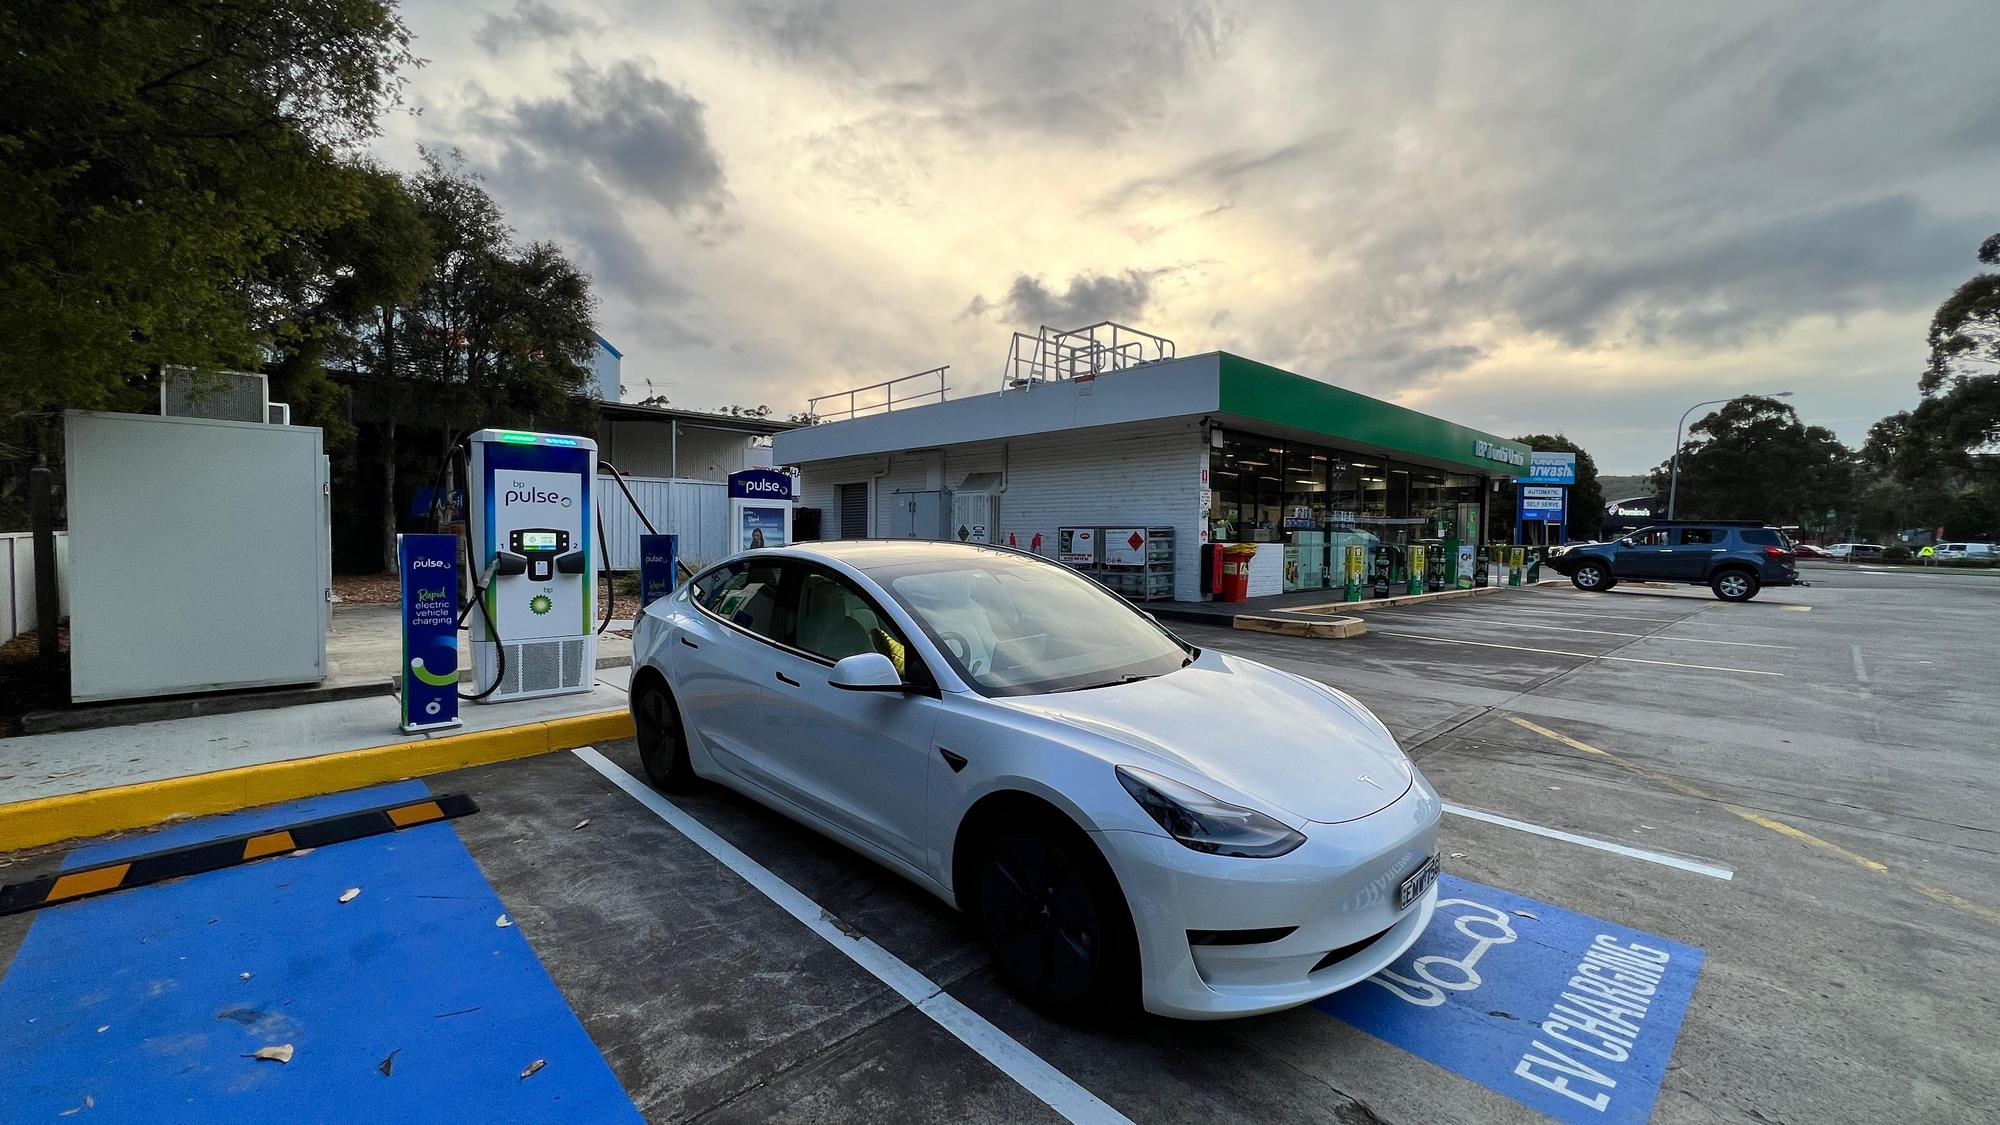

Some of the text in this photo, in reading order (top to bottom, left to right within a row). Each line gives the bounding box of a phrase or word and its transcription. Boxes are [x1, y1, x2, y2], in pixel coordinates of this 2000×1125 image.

[1530, 464, 1572, 477] arwash
[513, 480, 525, 488] bp
[746, 478, 780, 493] pulse
[505, 487, 559, 506] pulse
[1618, 507, 1651, 516] Domino's
[413, 558, 444, 570] pulse
[417, 587, 446, 602] Rapid
[415, 600, 450, 609] electric
[416, 608, 448, 616] vehicle
[412, 616, 452, 626] charging
[1514, 934, 1670, 1112] EV CHARGING
